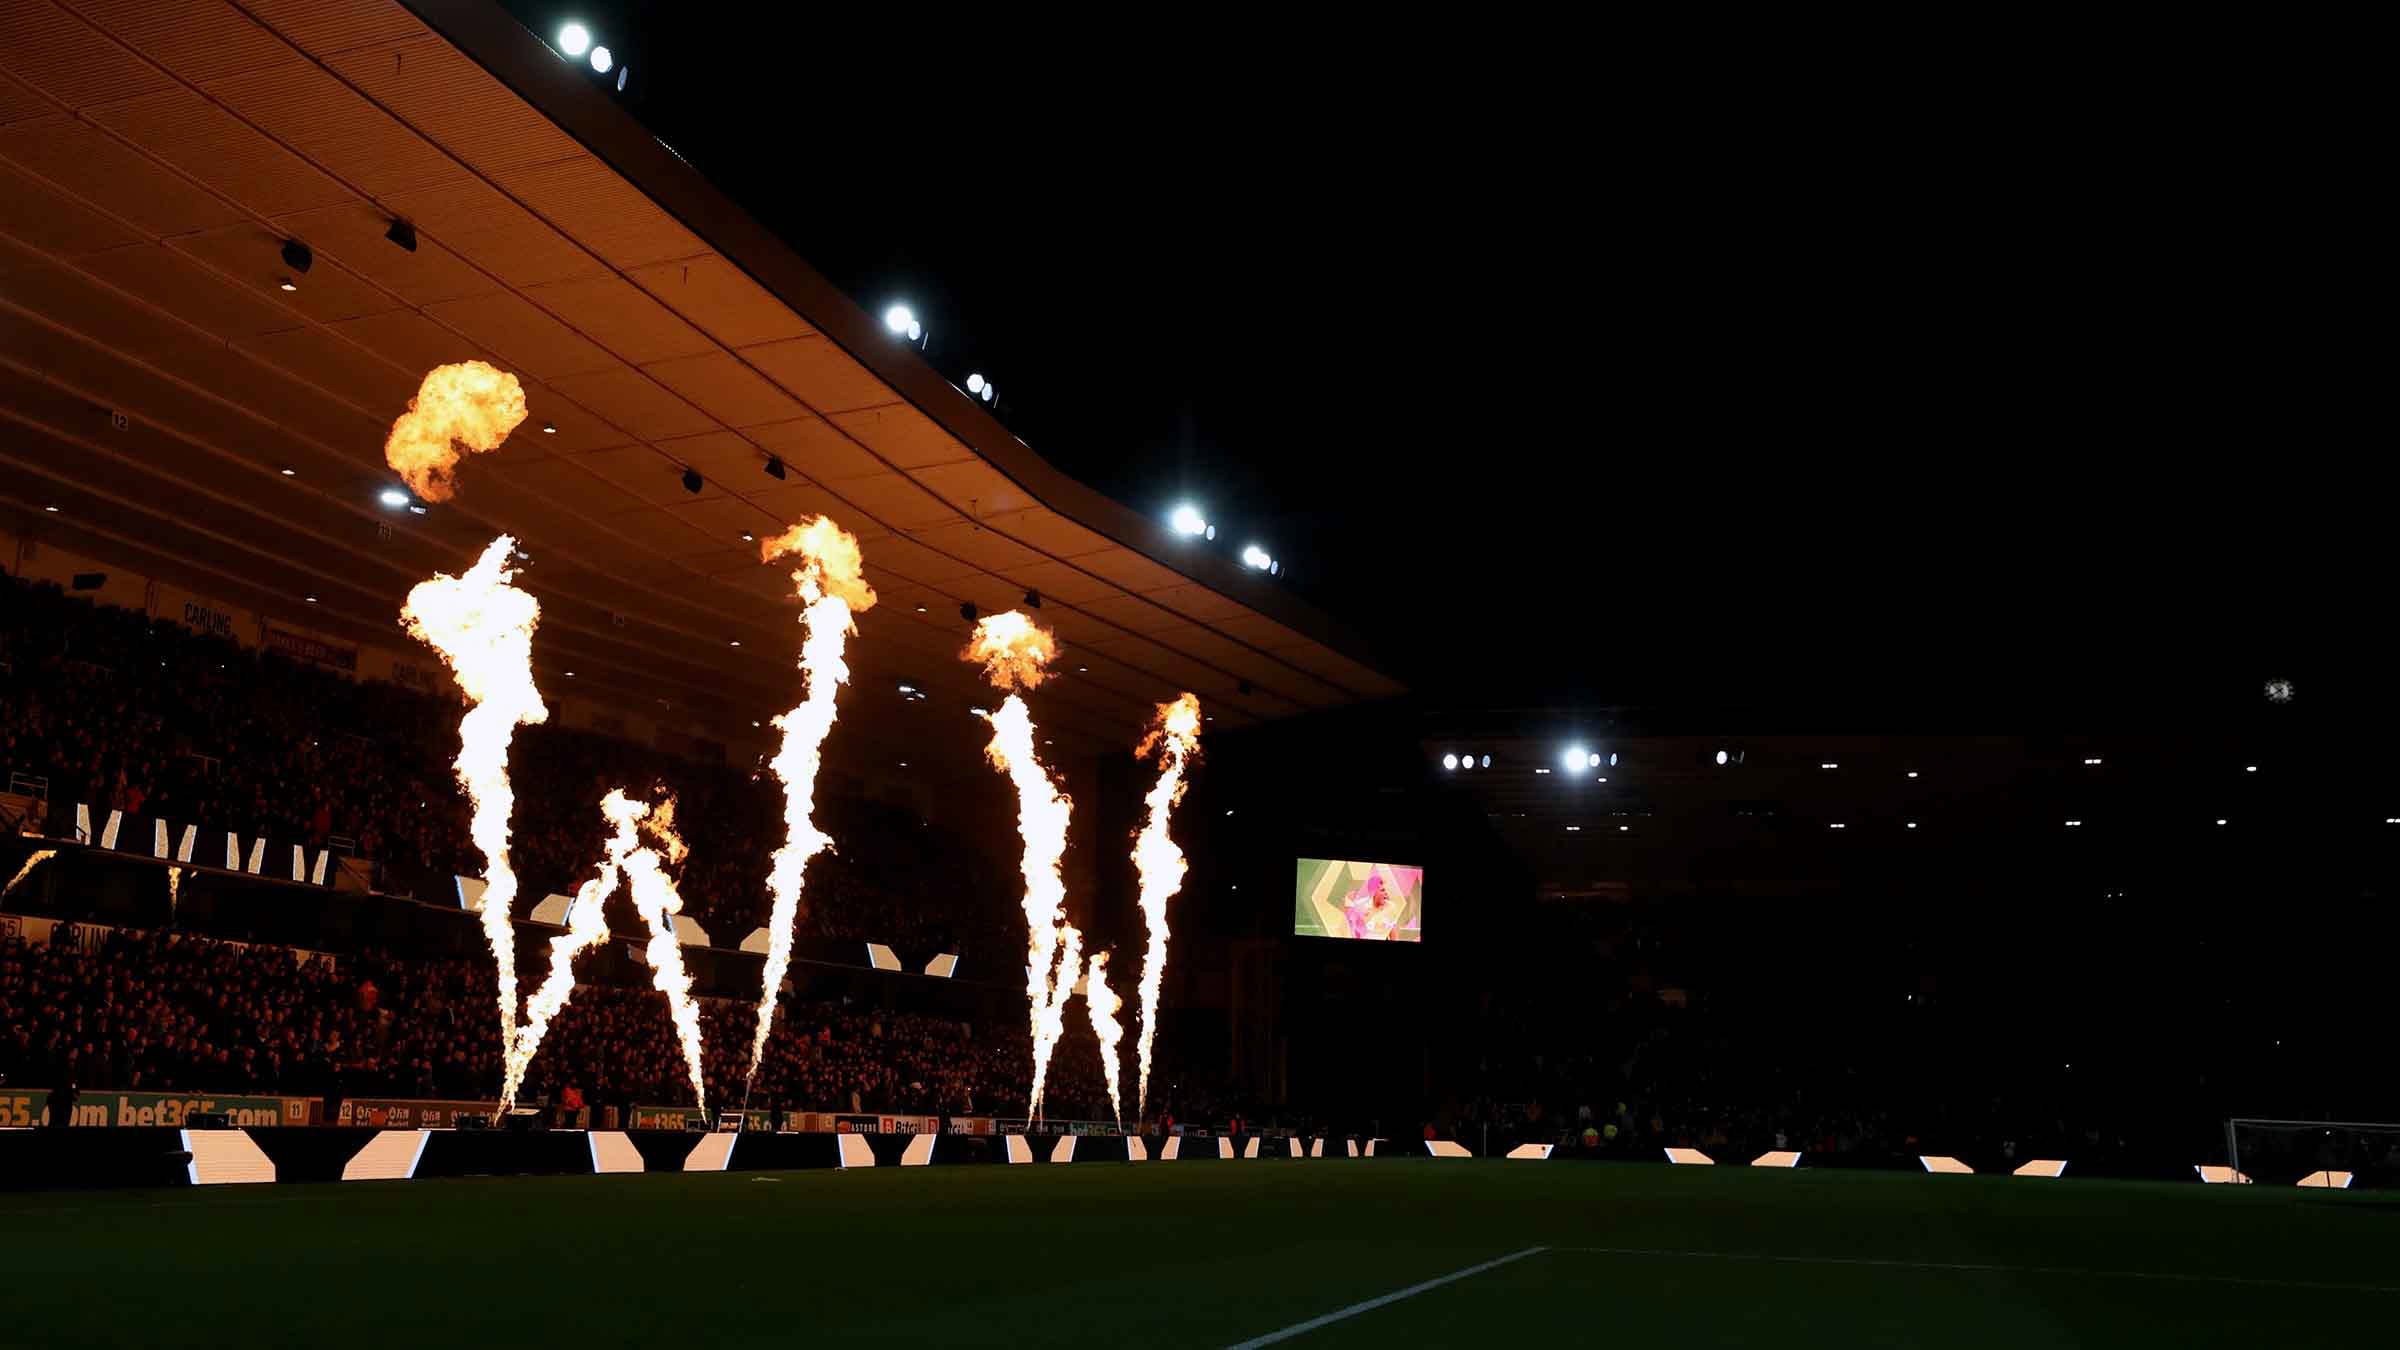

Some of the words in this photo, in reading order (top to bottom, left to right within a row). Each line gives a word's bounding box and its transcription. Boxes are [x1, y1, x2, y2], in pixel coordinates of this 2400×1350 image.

[184, 602, 232, 633] CARLING
[50, 922, 113, 953] CRLIN
[118, 1096, 277, 1127] bet36com
